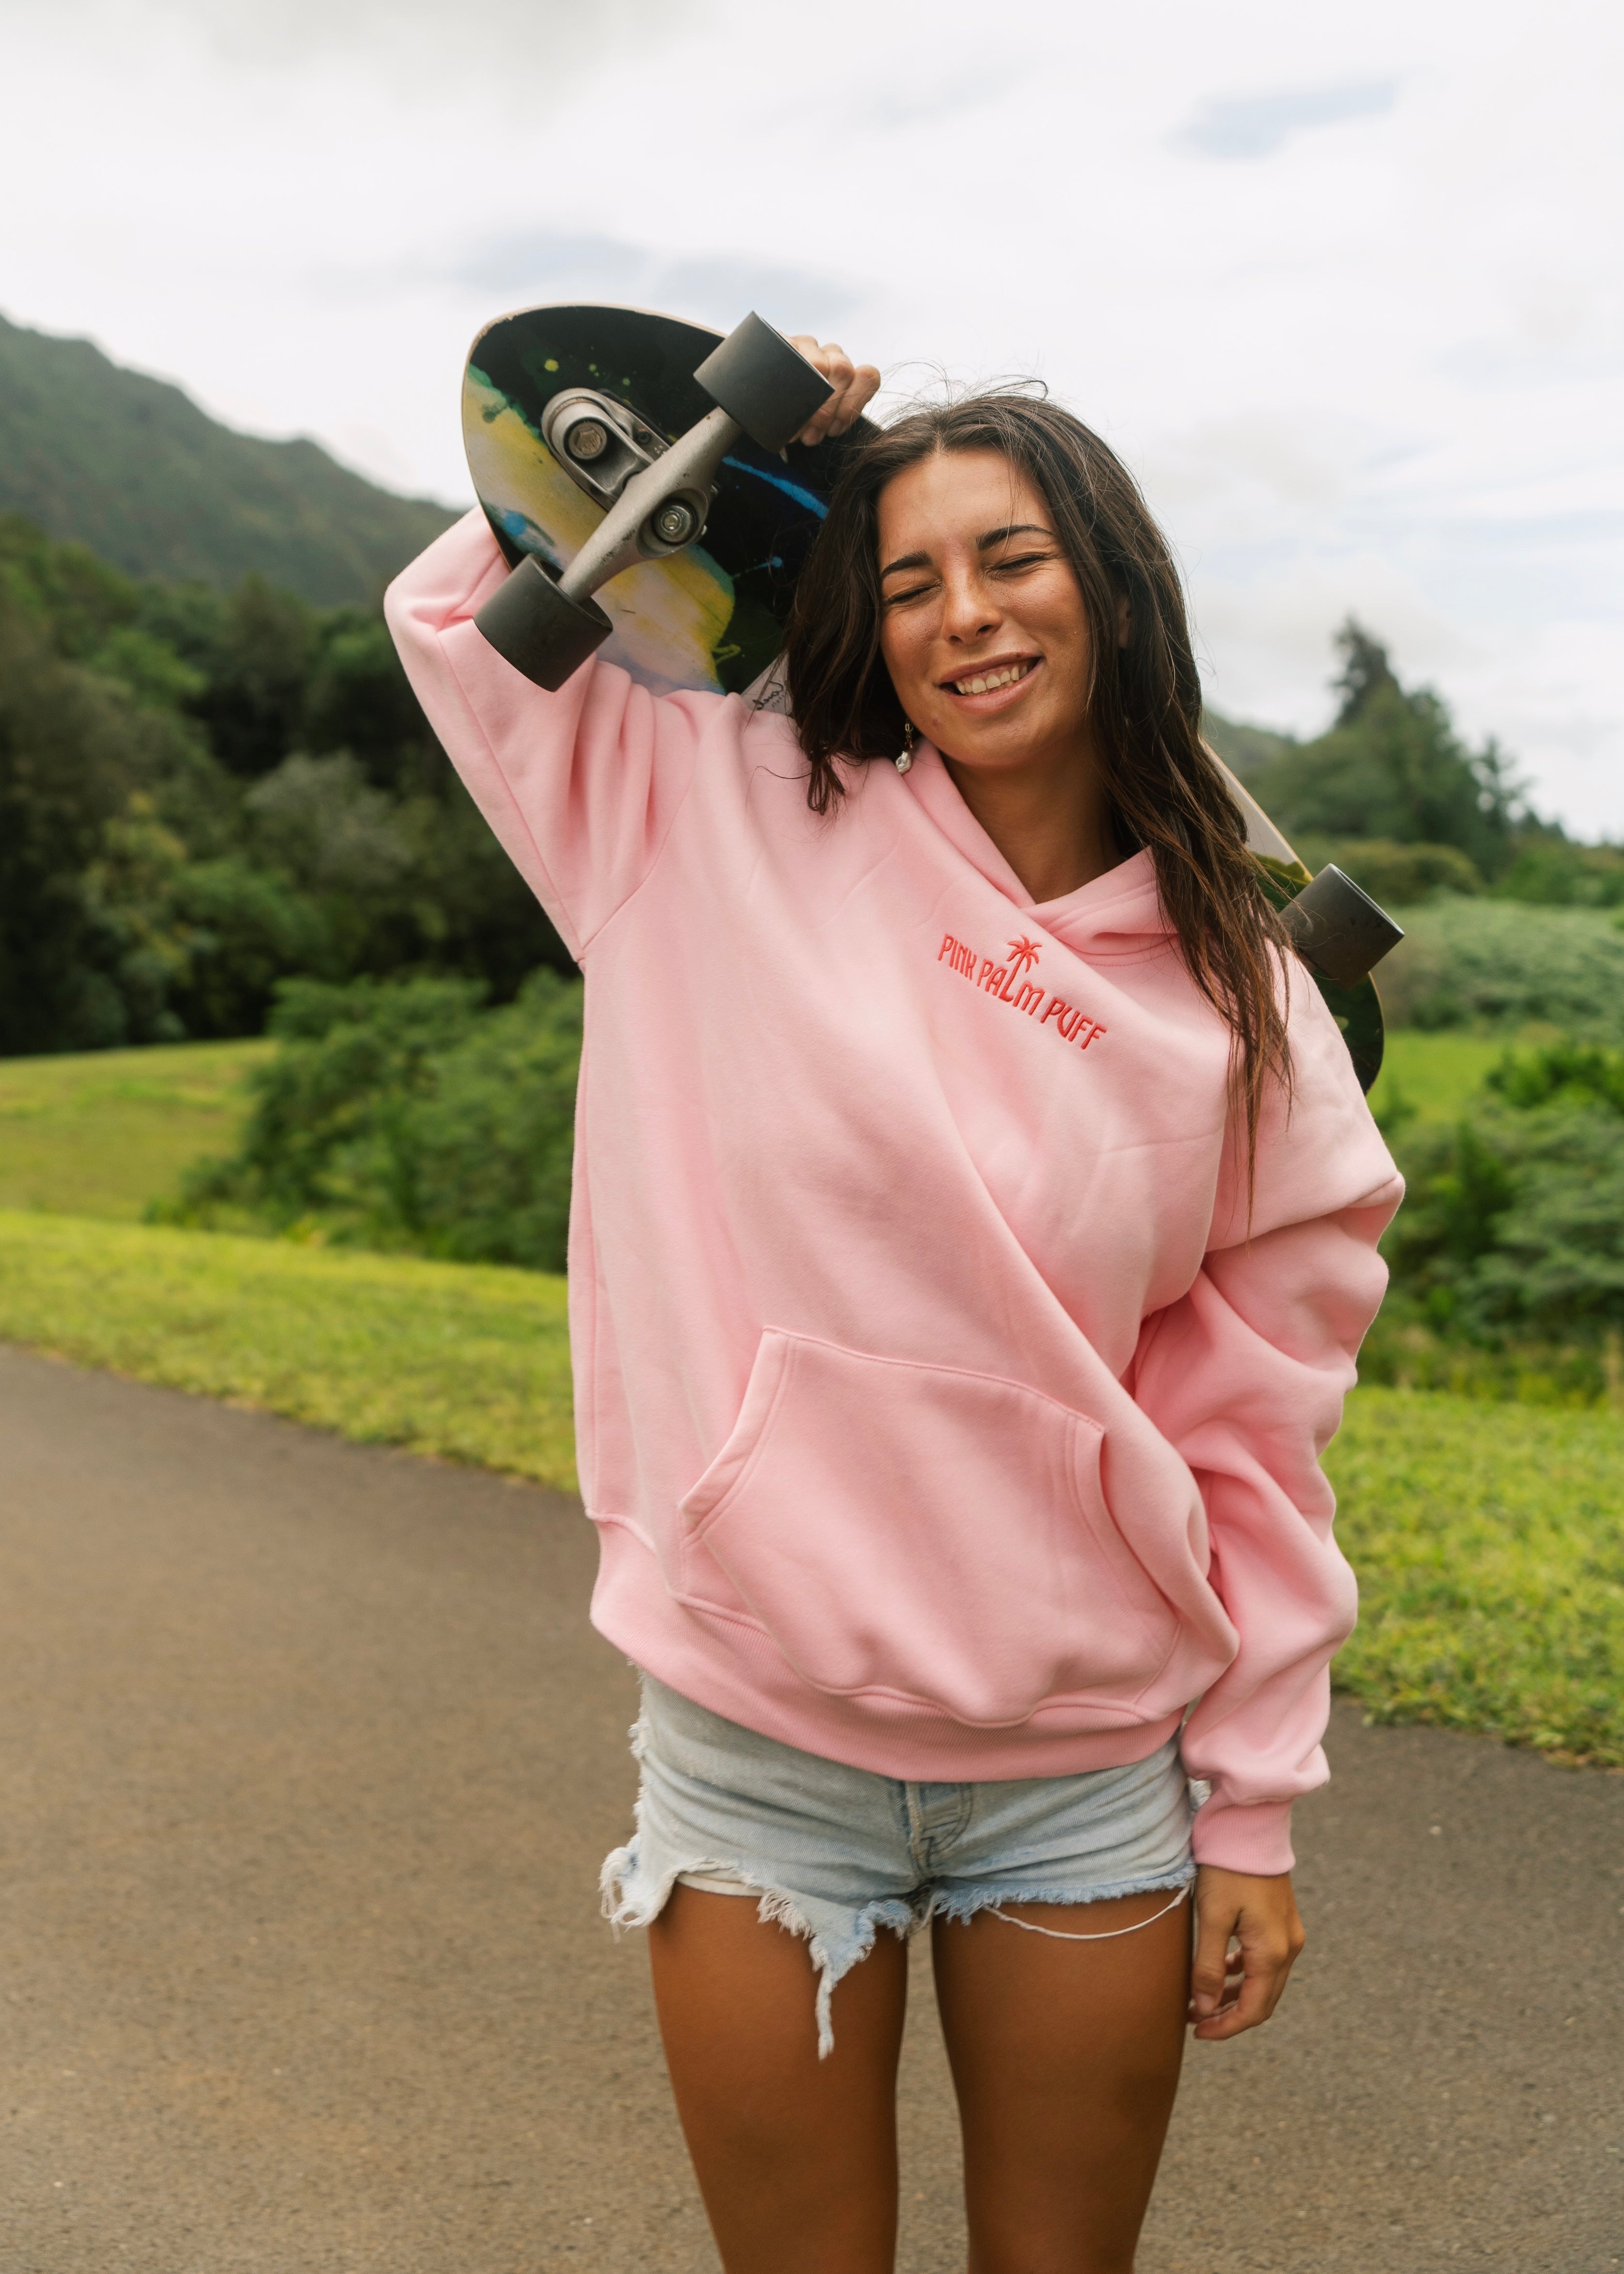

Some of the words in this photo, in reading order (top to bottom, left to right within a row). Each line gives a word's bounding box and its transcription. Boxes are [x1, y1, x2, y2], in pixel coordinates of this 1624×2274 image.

[938, 934, 977, 981] PINK
[976, 935, 1046, 1016] PALM
[1040, 997, 1107, 1050] PUFF
